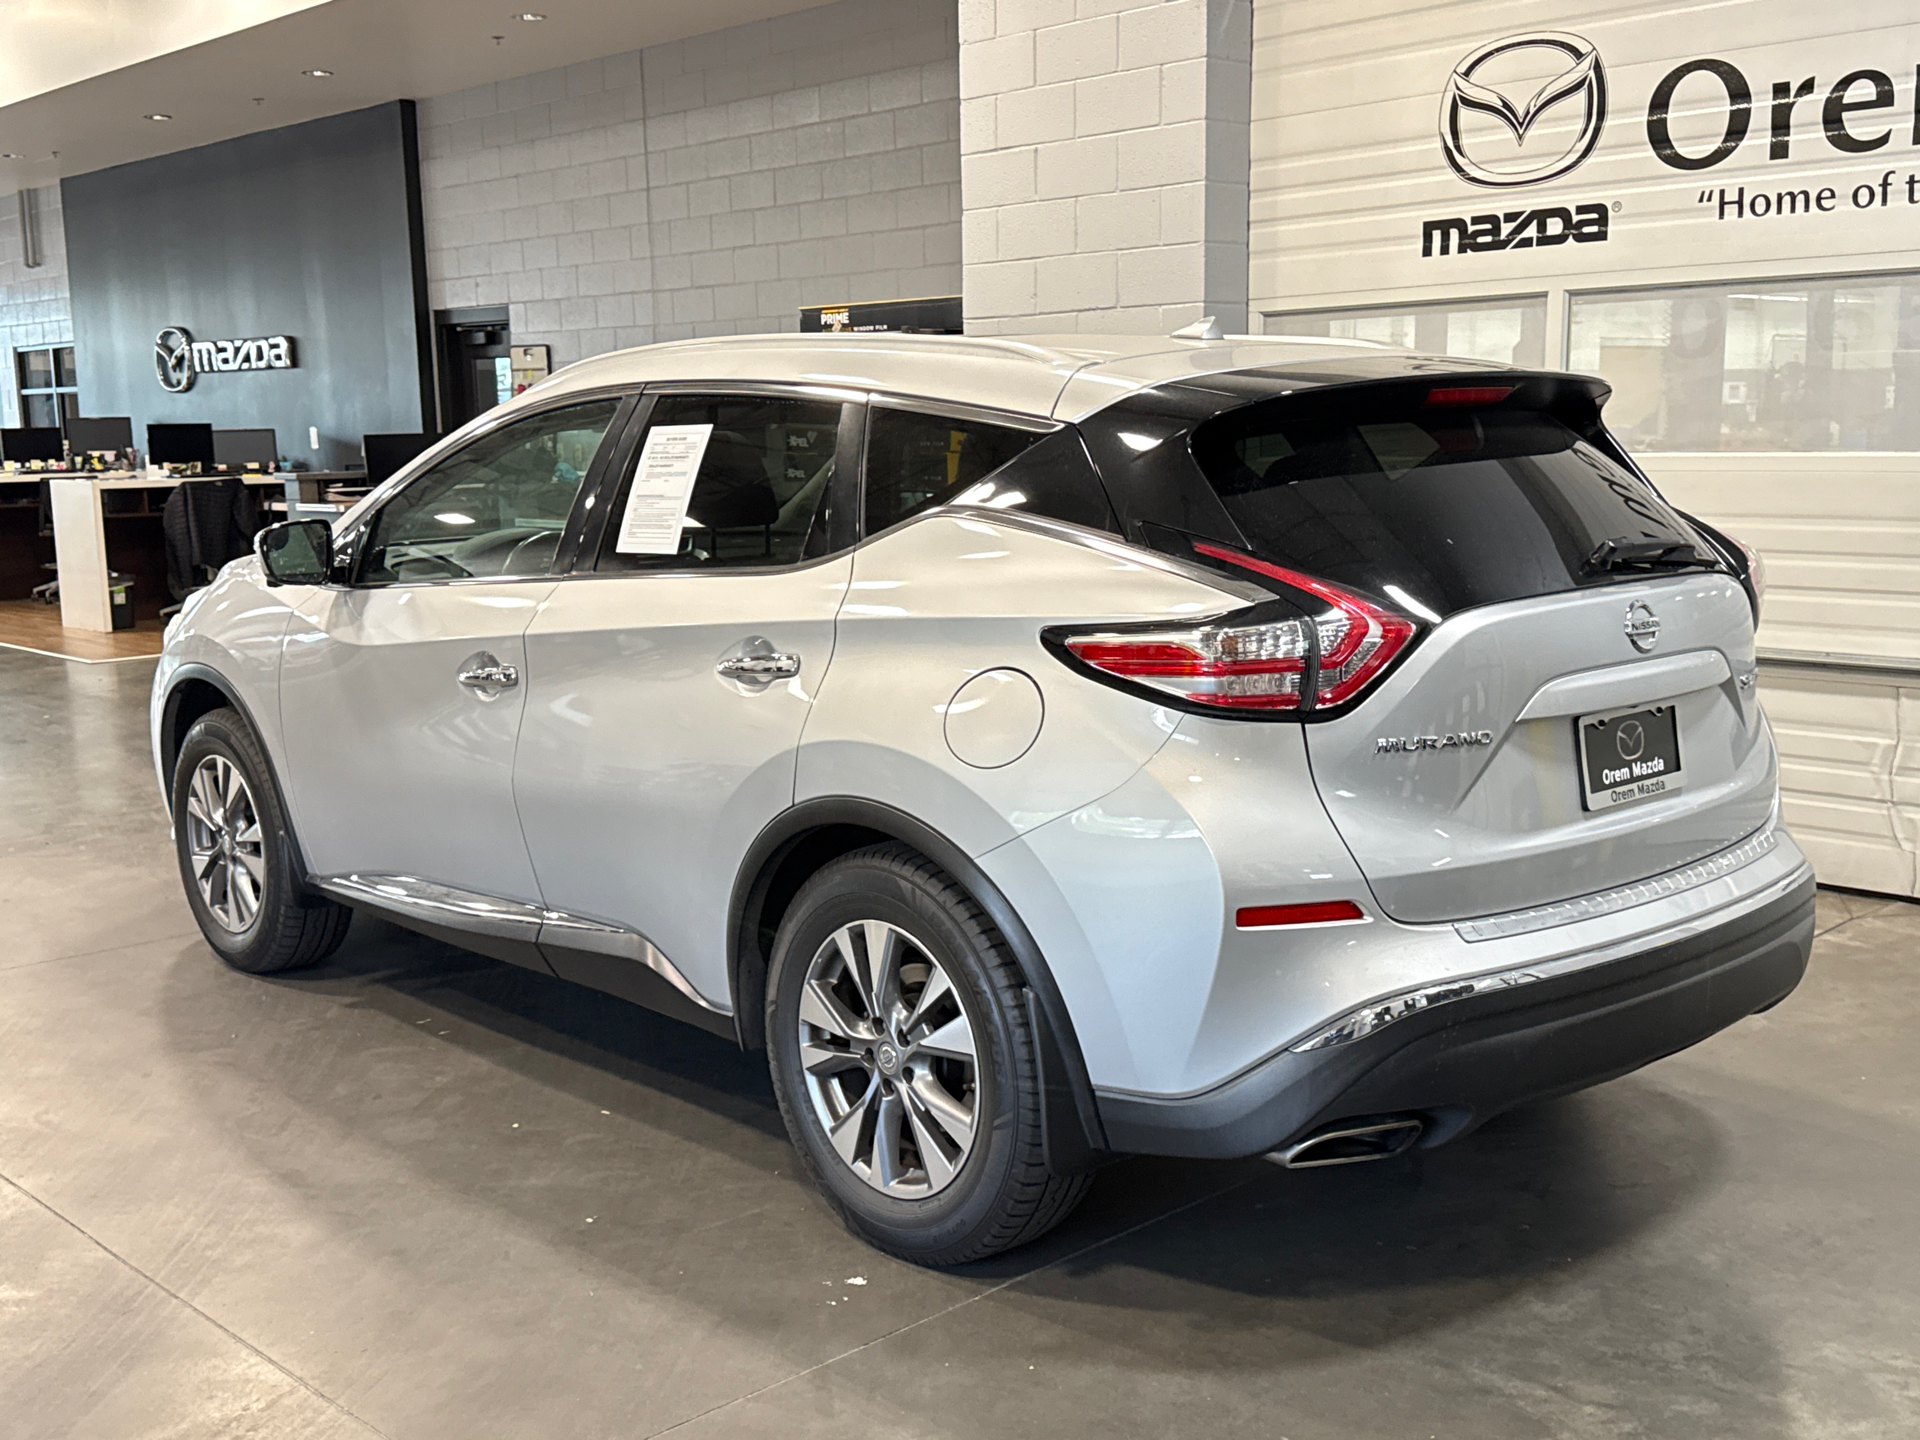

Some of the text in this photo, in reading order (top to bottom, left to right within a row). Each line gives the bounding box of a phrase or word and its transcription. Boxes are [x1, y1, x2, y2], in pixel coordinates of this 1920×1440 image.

[1646, 58, 1920, 171] Ore
[1852, 170, 1896, 209] of
[820, 312, 850, 325] PRIME
[1631, 620, 1660, 631] NISSAN
[1374, 729, 1494, 754] MURANO
[1602, 756, 1665, 785] Orem Mazda
[1610, 779, 1666, 803] Orem Mazda
